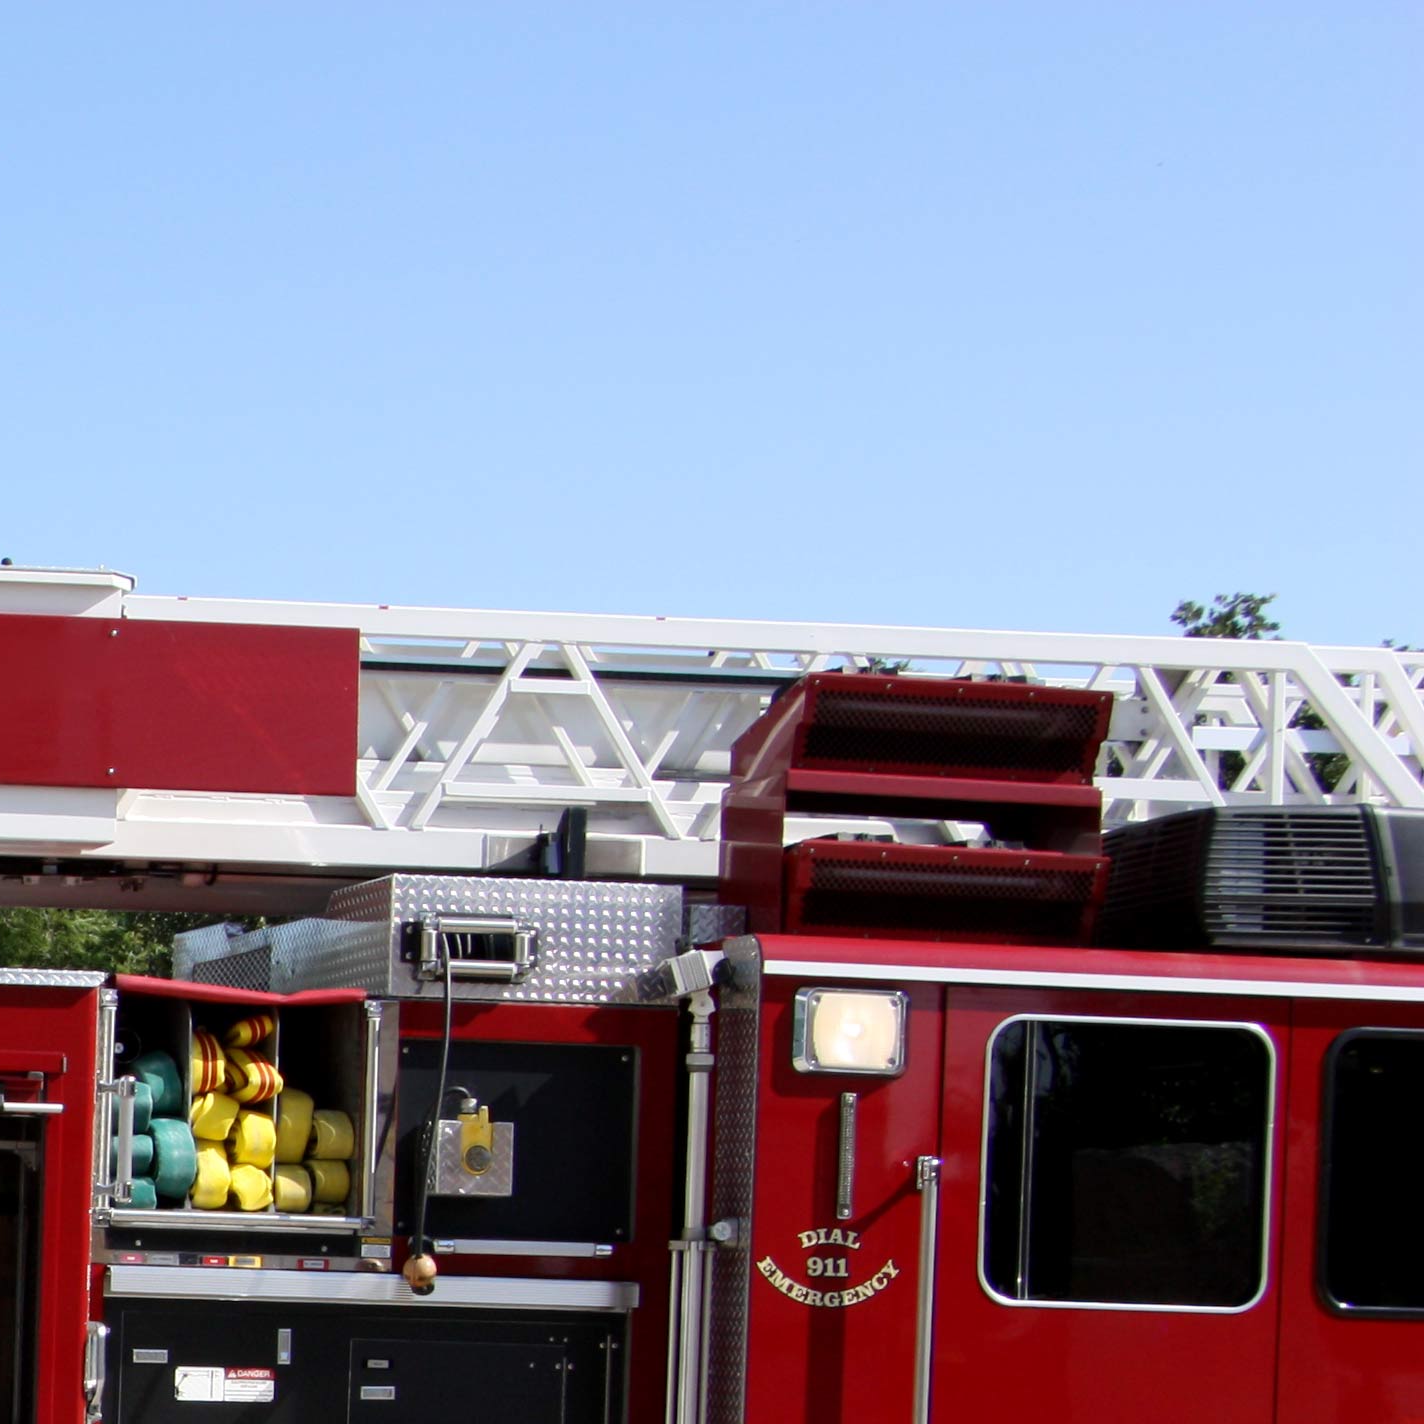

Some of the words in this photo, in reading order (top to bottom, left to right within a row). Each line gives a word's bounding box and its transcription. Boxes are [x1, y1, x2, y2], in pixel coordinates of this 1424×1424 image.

[797, 1228, 861, 1249] DIAL
[806, 1256, 849, 1277] 911
[756, 1256, 900, 1308] EMERGENCY
[237, 1369, 270, 1378] DANGER
